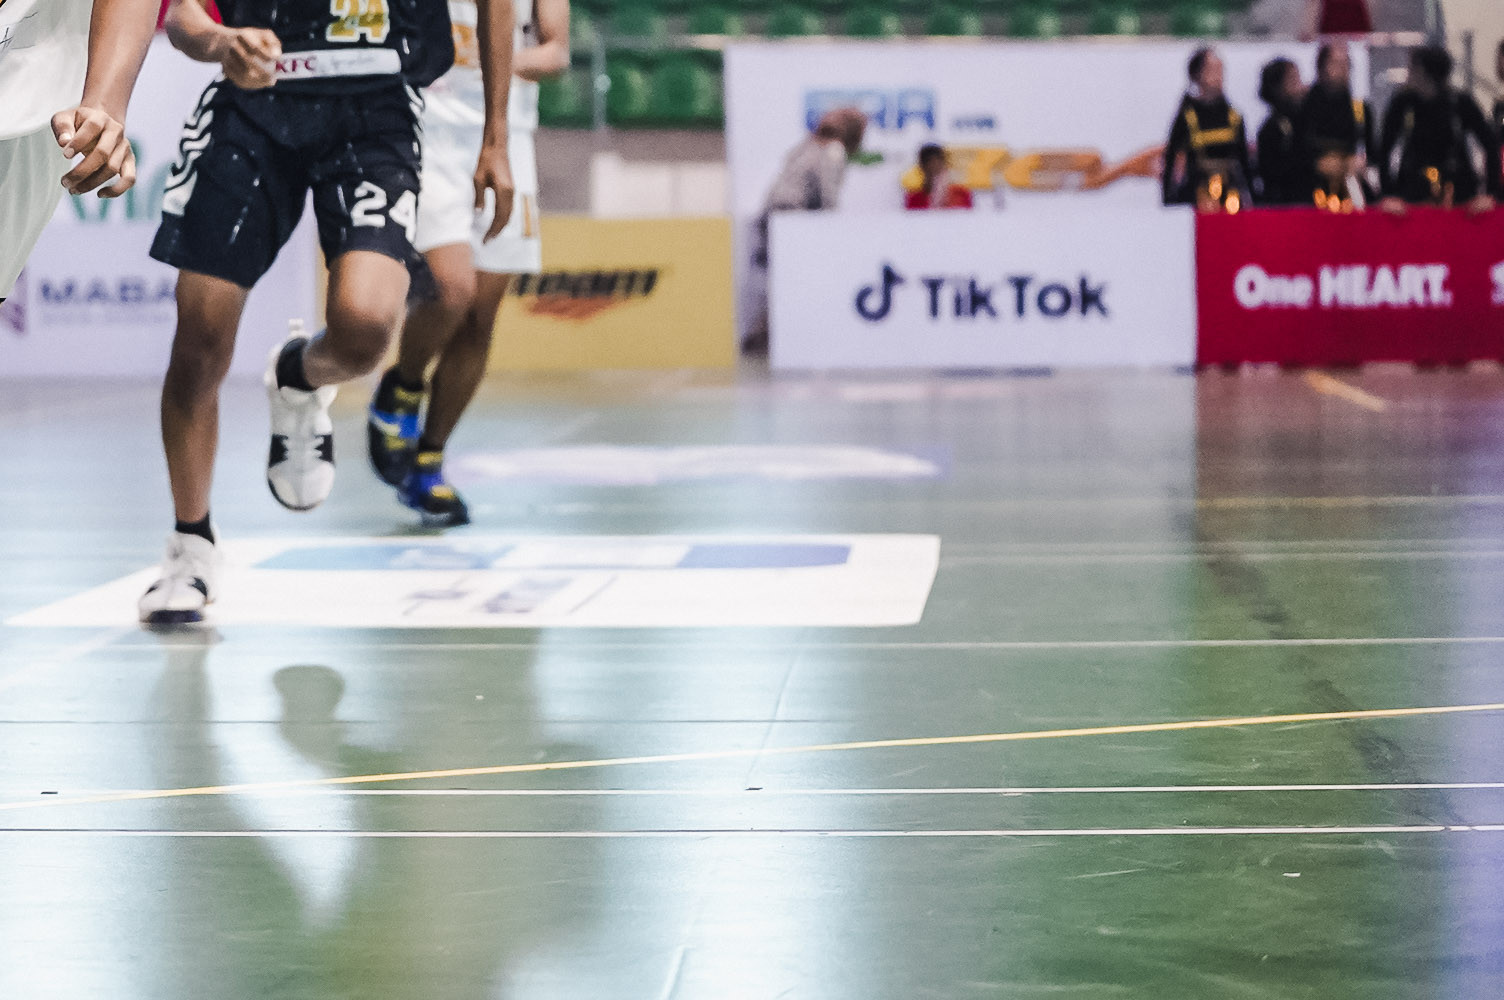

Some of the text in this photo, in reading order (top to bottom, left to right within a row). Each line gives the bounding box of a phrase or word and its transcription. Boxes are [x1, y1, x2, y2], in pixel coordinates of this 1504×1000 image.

[276, 56, 317, 74] KFC
[350, 181, 418, 244] 24
[40, 277, 176, 303] MABA
[920, 273, 1110, 320] TikTok
[1234, 264, 1314, 309] One
